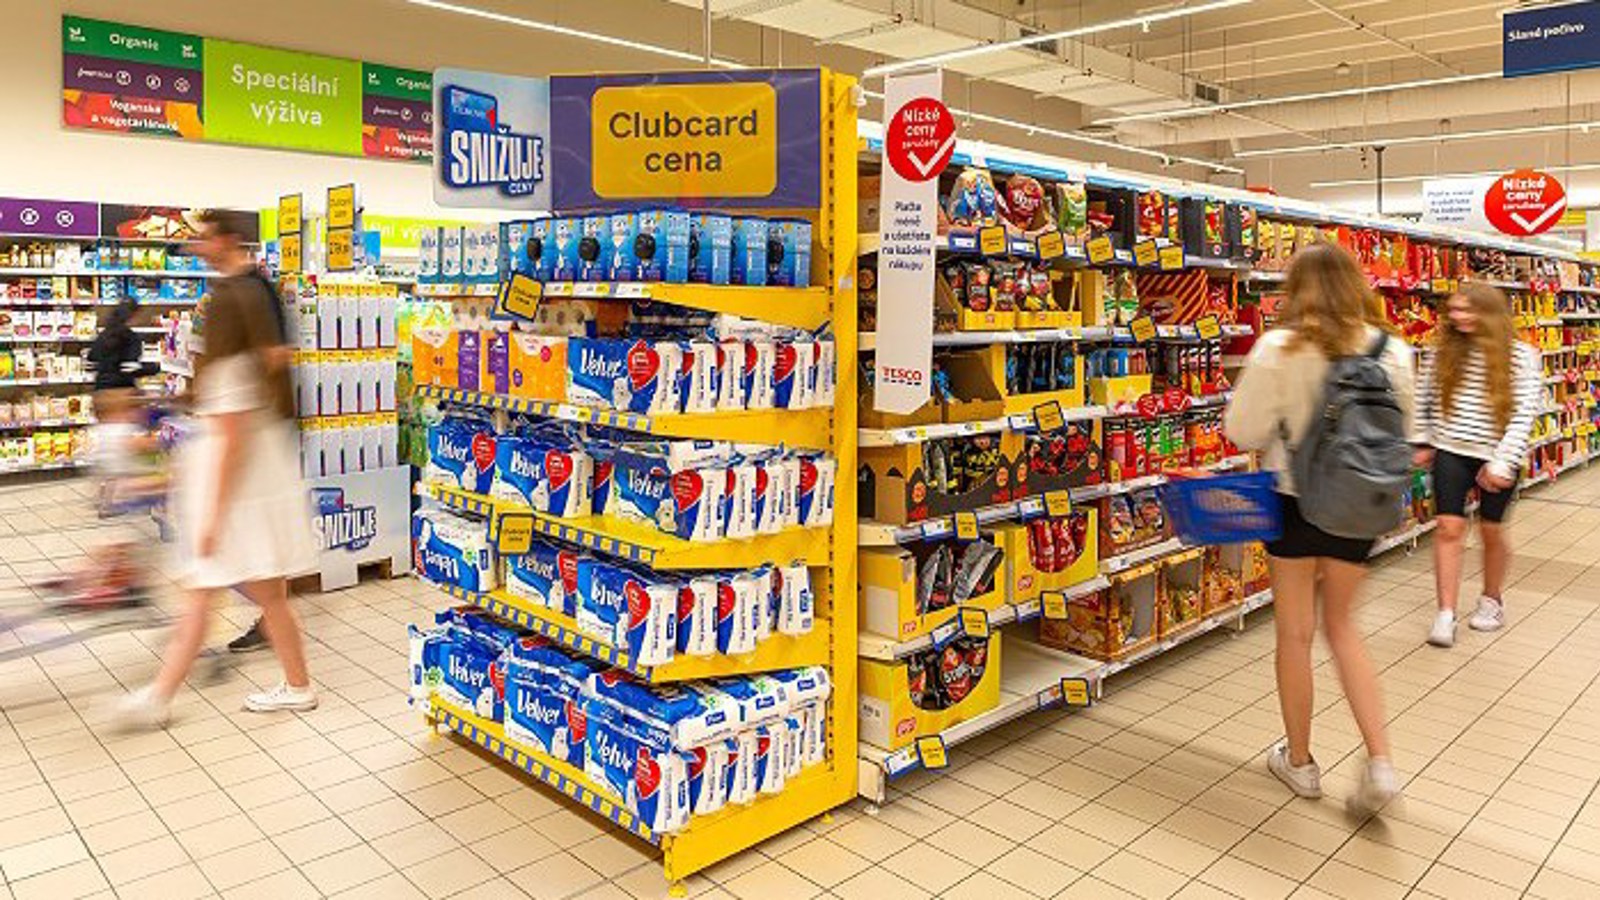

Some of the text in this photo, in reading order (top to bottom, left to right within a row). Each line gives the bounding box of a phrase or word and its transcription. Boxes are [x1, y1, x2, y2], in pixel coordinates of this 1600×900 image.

[109, 33, 159, 51] Organic
[1508, 27, 1542, 41] Slané
[231, 63, 339, 97] Speciální
[250, 99, 322, 126] výživa
[609, 109, 758, 138] Clubcard
[905, 123, 936, 139] ceny
[450, 128, 542, 184] SNIŽUJE
[644, 151, 722, 172] cena
[882, 366, 922, 380] TESCO
